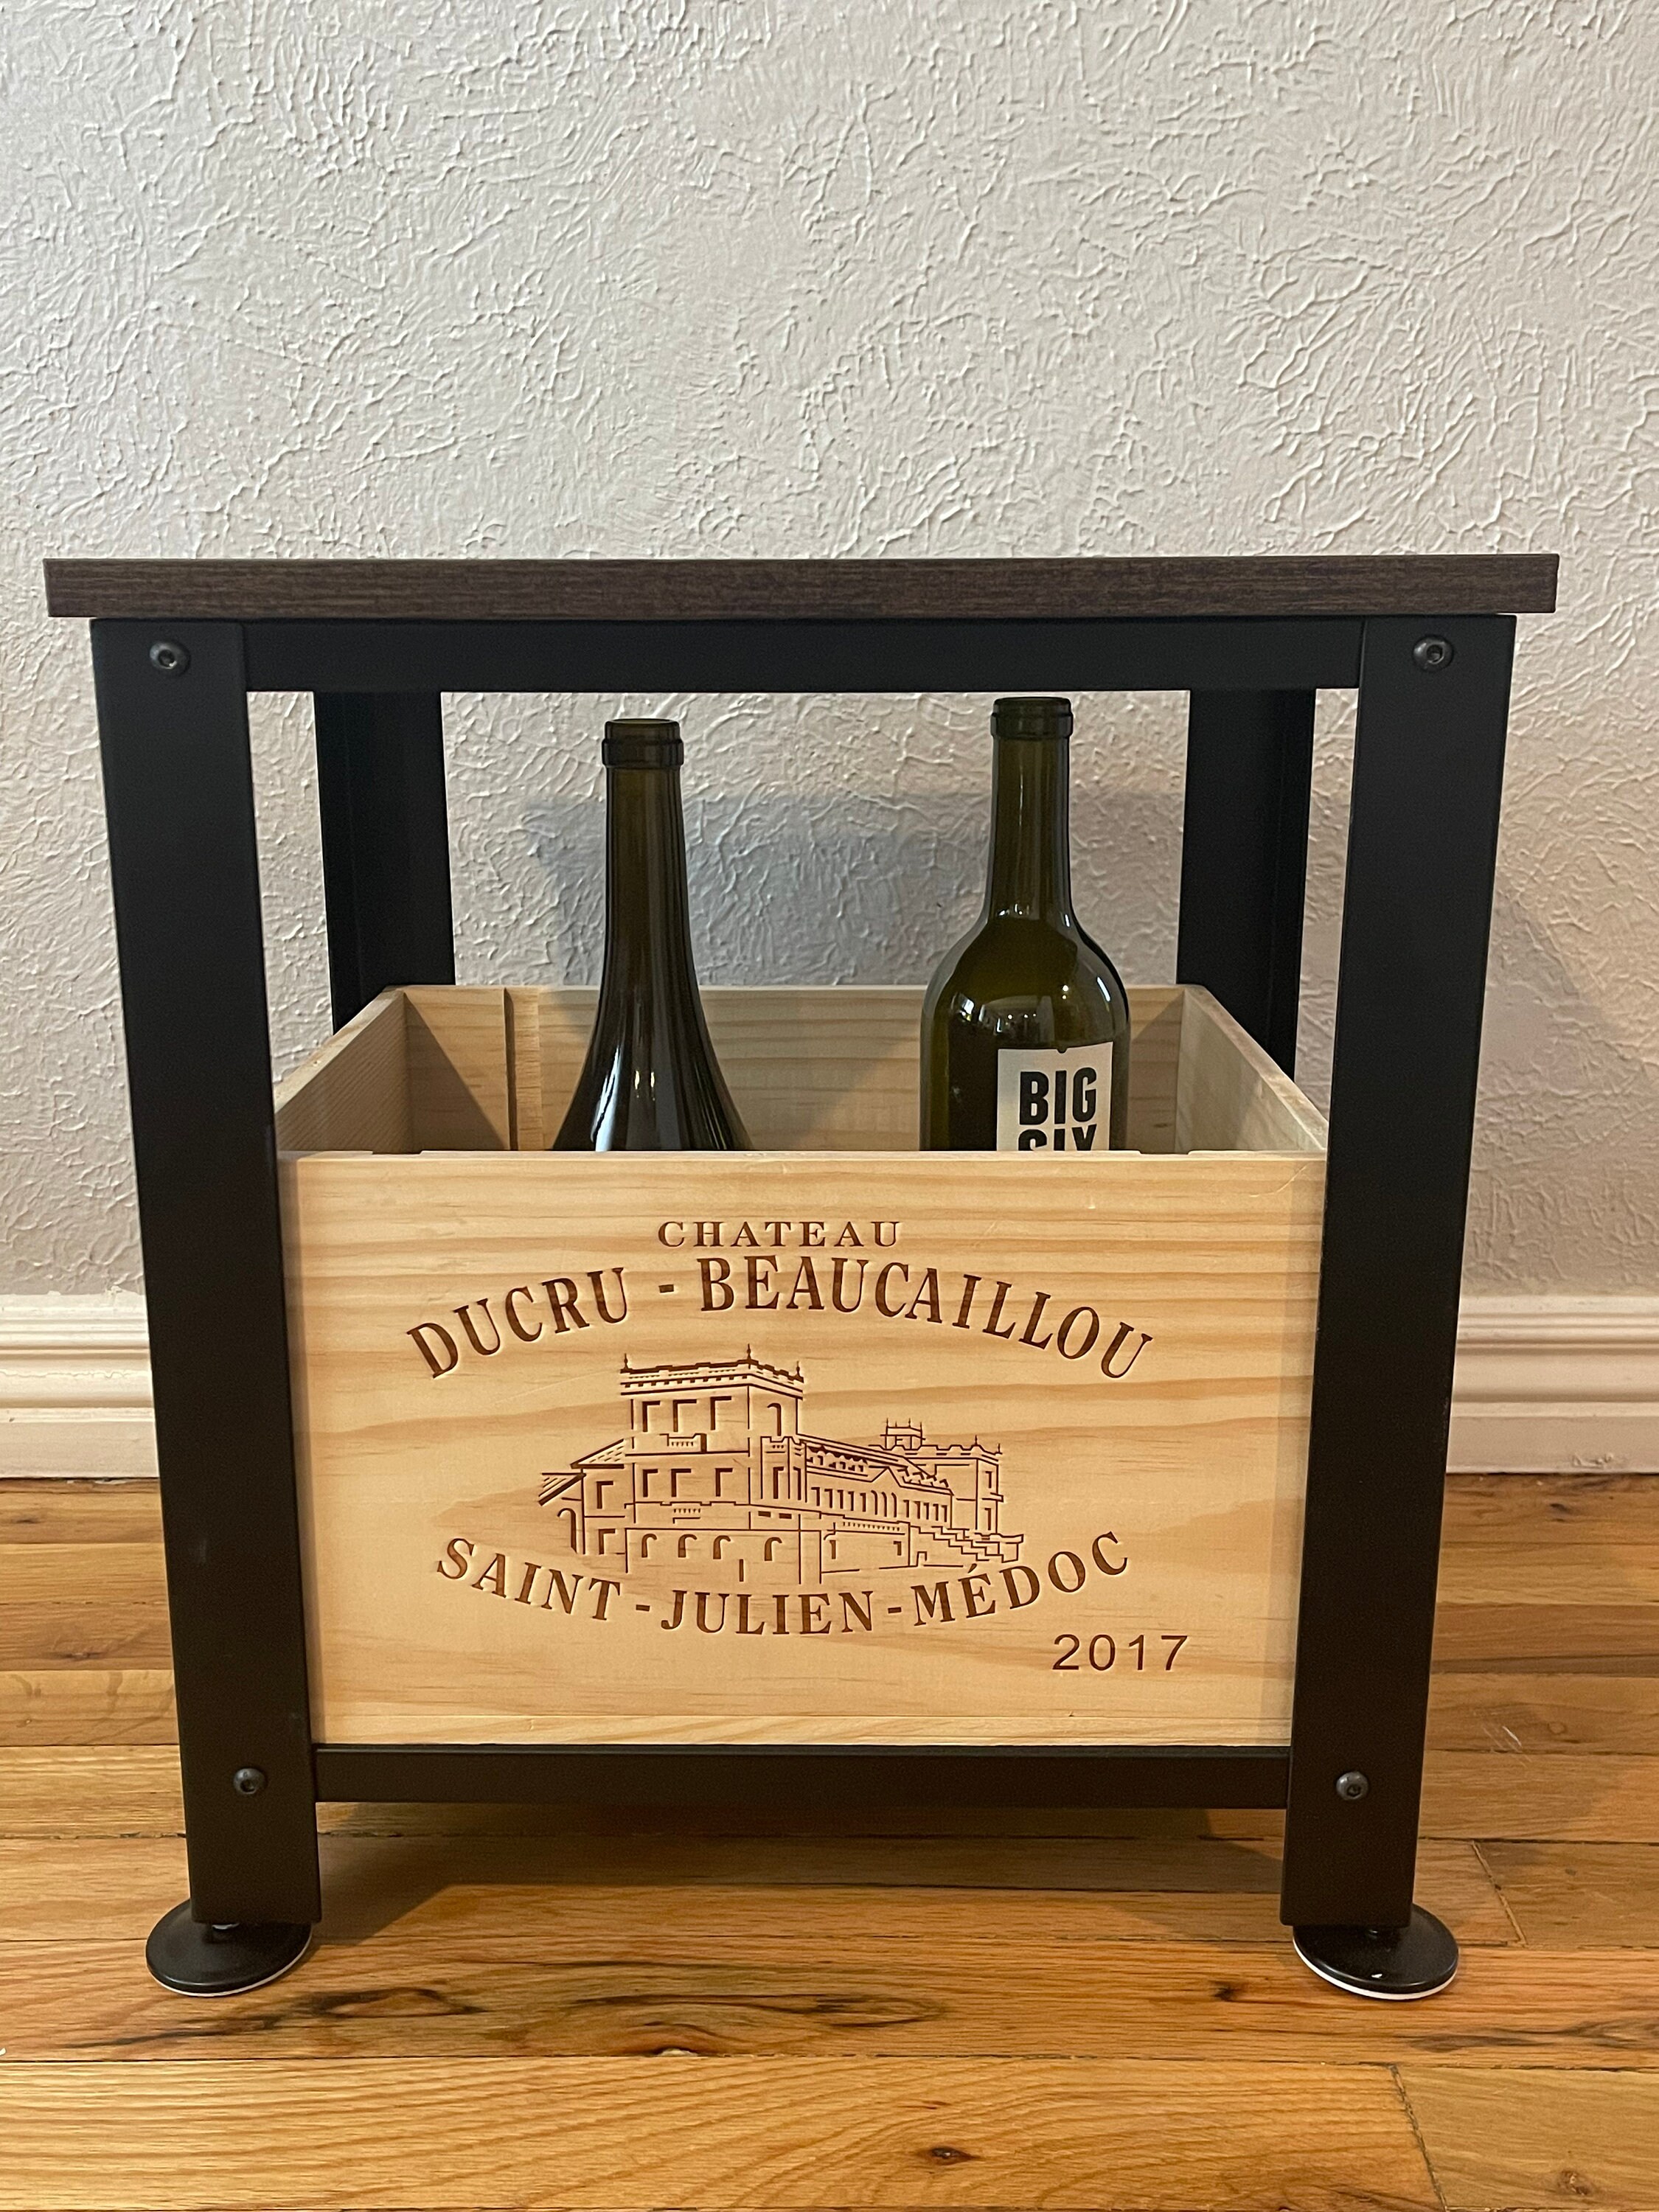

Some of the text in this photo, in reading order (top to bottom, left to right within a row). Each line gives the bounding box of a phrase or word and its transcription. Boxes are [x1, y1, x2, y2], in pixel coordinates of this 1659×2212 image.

[1019, 1066, 1098, 1125] BIG
[657, 1220, 900, 1248] CHATEAU
[406, 1267, 627, 1379] DUCRU
[696, 1254, 1154, 1379] BEAUCAILLOU
[1051, 1633, 1189, 1672] 2017
